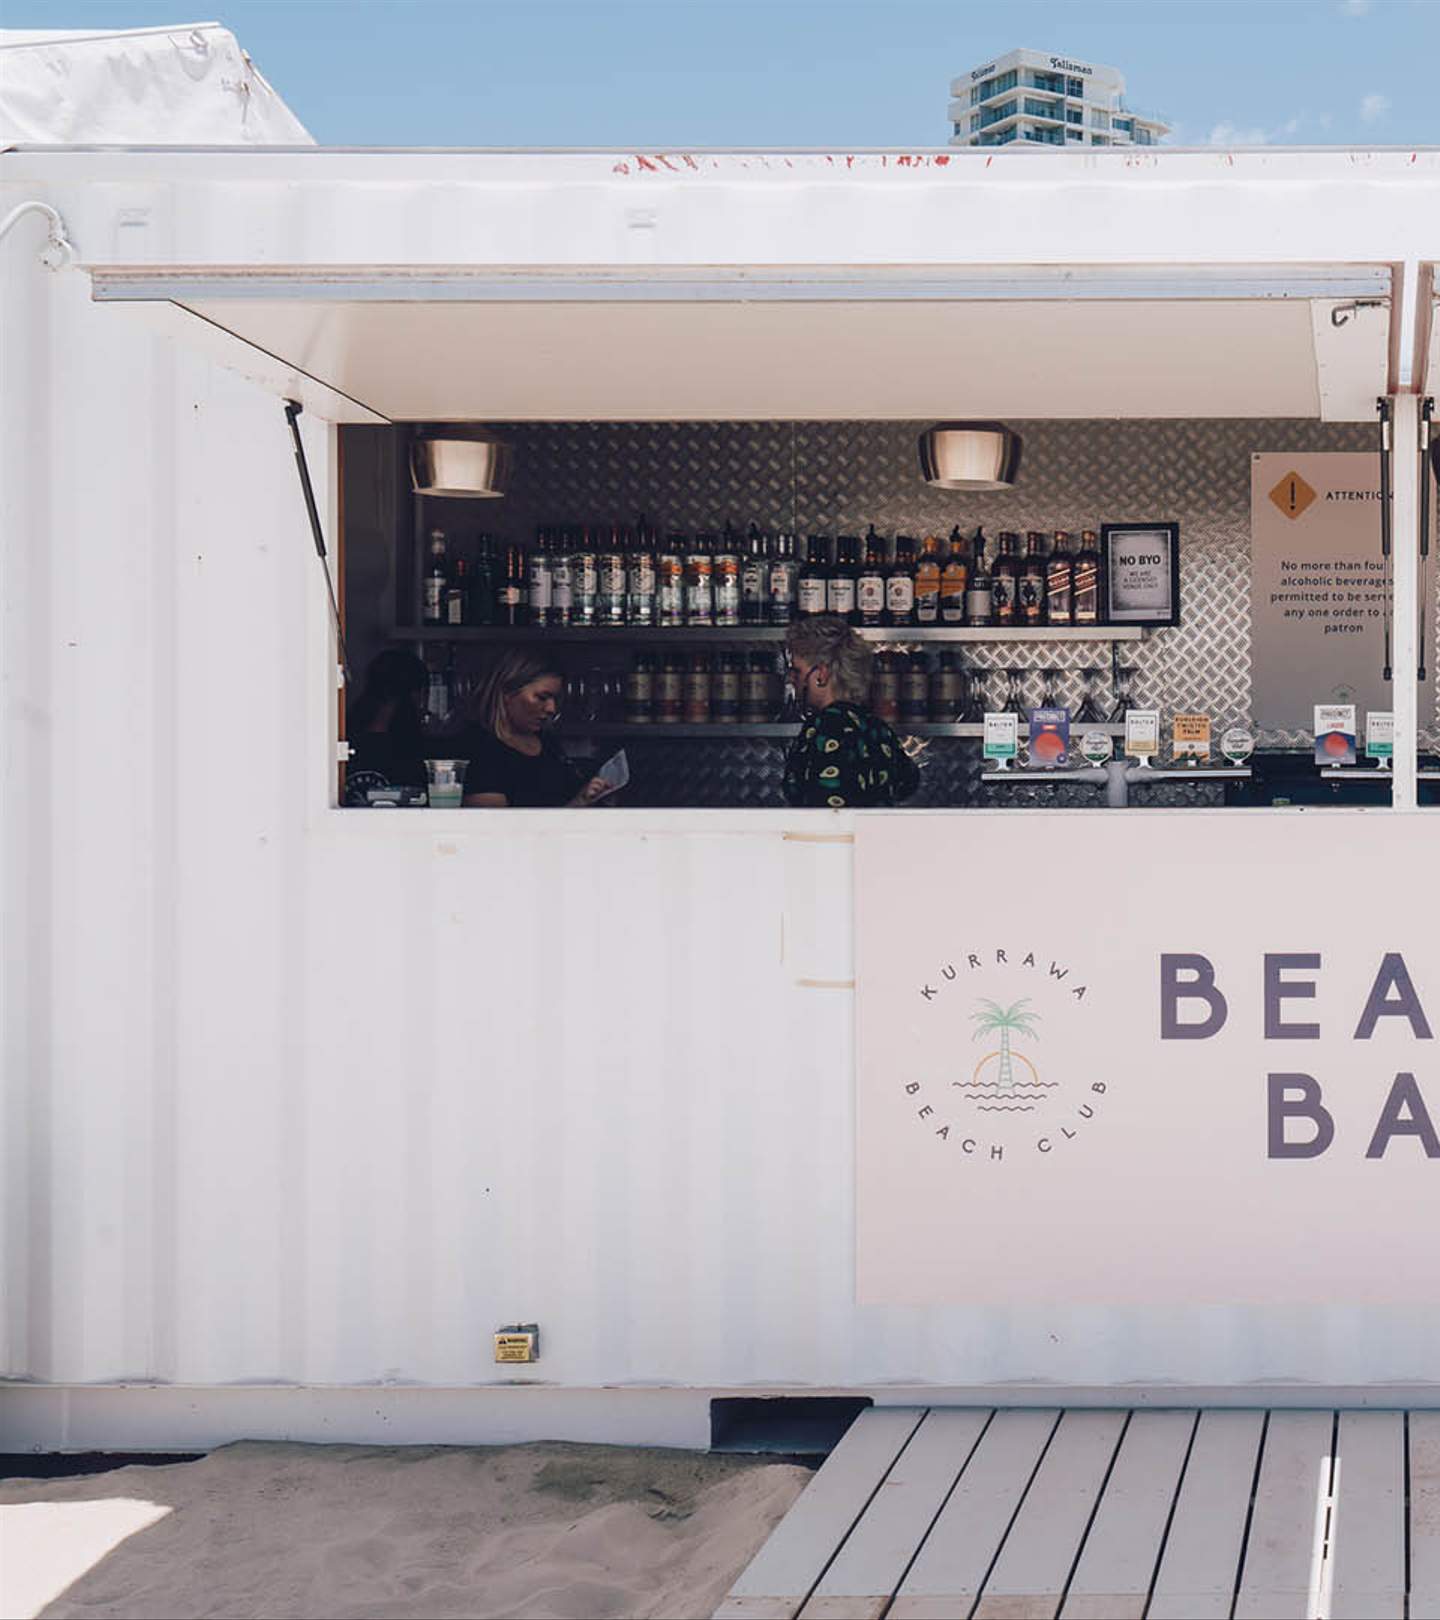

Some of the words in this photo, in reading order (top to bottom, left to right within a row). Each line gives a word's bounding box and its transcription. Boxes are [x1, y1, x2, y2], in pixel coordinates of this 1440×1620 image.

[1120, 555, 1136, 567] NO
[1138, 554, 1161, 566] BYO
[1281, 561, 1298, 571] No
[1301, 563, 1331, 572] more
[1334, 561, 1362, 572] than
[1280, 576, 1332, 587] alcoholic
[1270, 591, 1328, 604] permitted
[1332, 592, 1344, 602] to
[1347, 591, 1361, 602] be
[1284, 609, 1304, 620] any
[1308, 609, 1330, 617] one
[1333, 607, 1364, 617] order
[1367, 608, 1379, 617] to
[1324, 623, 1363, 634] patron
[920, 948, 1087, 1001] KURRAWA
[905, 1081, 1003, 1161] BEACH
[1037, 1081, 1107, 1153] CLUB
